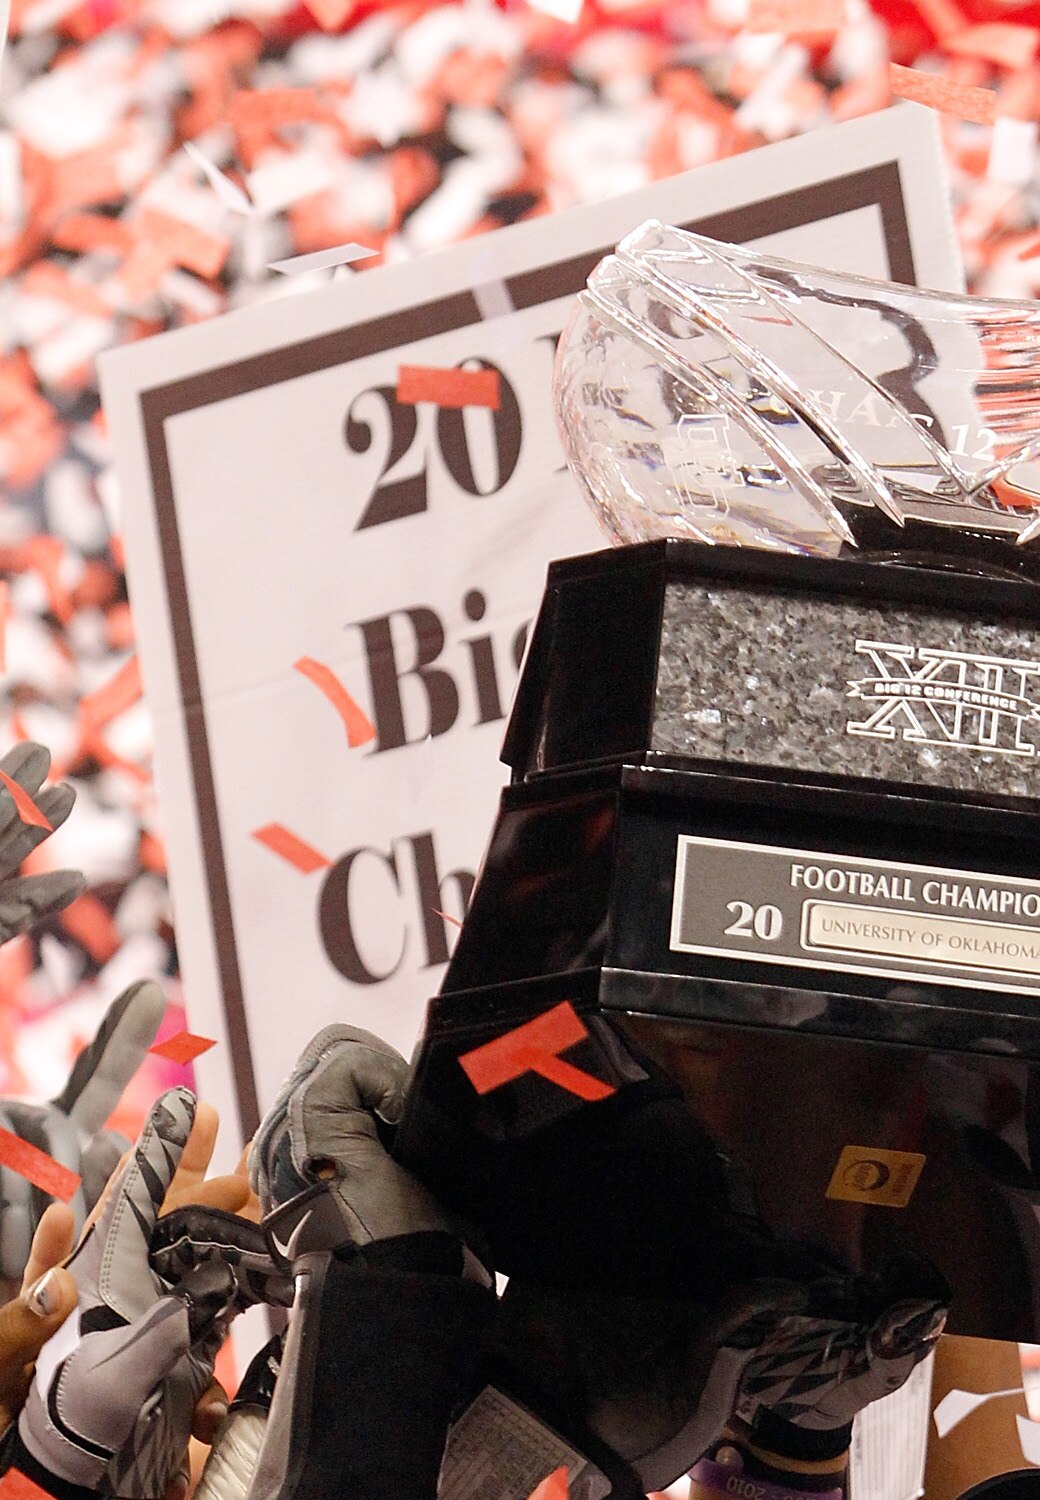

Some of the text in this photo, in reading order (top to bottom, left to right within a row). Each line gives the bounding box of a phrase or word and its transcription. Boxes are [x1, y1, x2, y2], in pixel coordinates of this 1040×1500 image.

[346, 588, 534, 757] Bi
[874, 683, 1018, 712] BIG 12 CONFERENCE
[790, 864, 916, 903] FOOTBALL
[723, 899, 783, 941] 20
[821, 917, 917, 945] UNIVERSITY
[921, 931, 943, 948] OF
